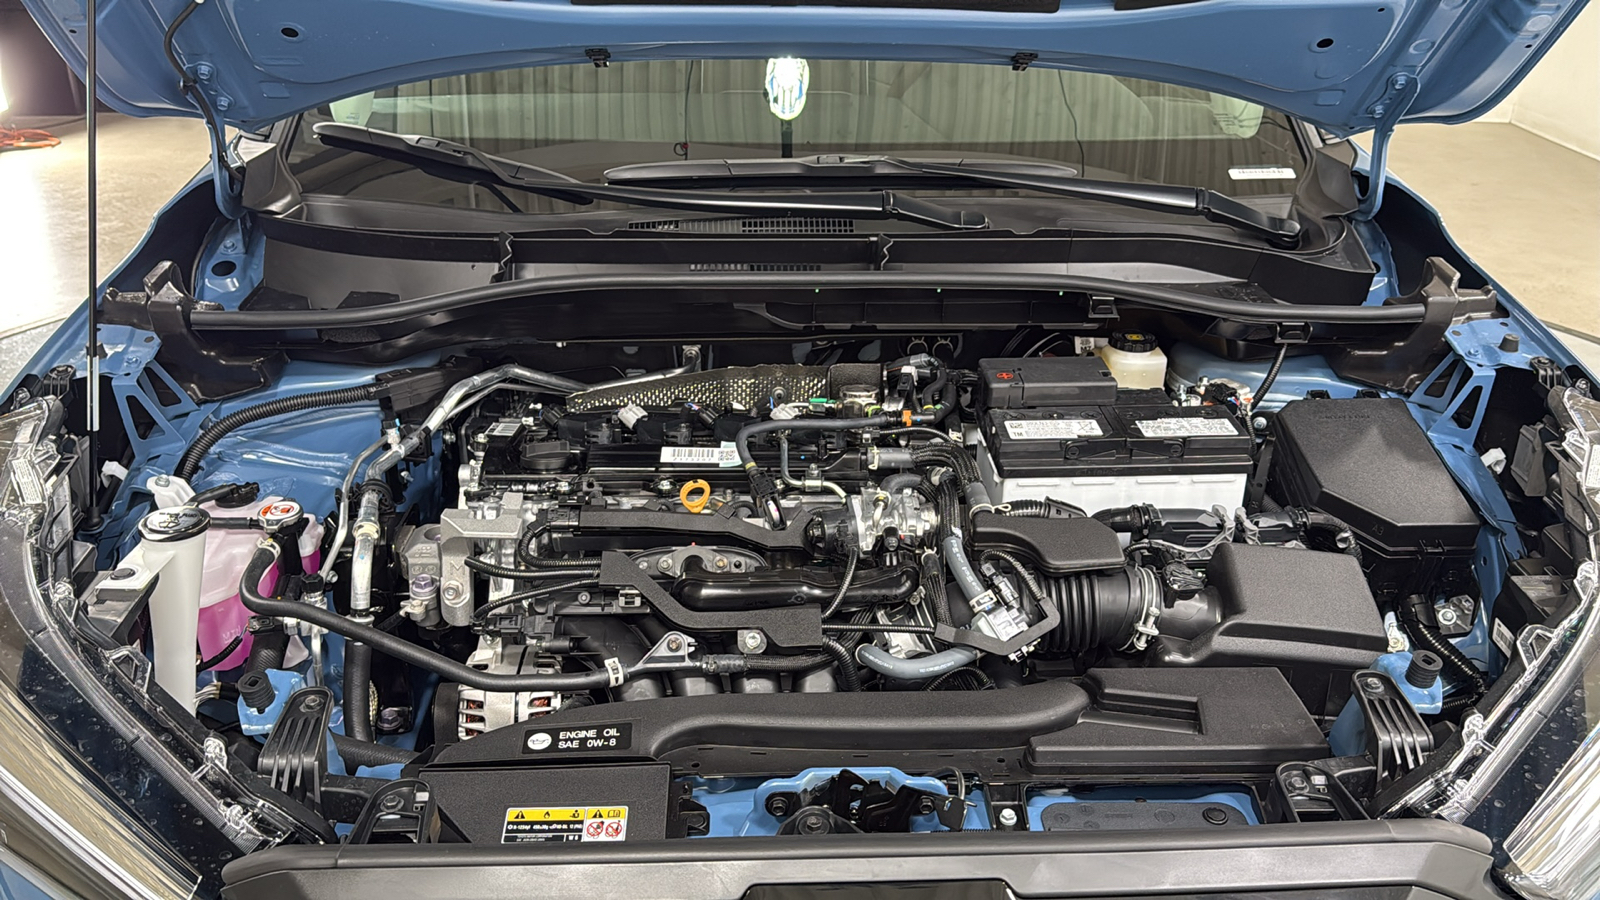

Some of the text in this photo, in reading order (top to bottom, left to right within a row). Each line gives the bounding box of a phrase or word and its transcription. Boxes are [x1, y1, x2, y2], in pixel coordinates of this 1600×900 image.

[559, 728, 621, 739] ENGINE OIL
[558, 738, 617, 749] SAE 0W-8
